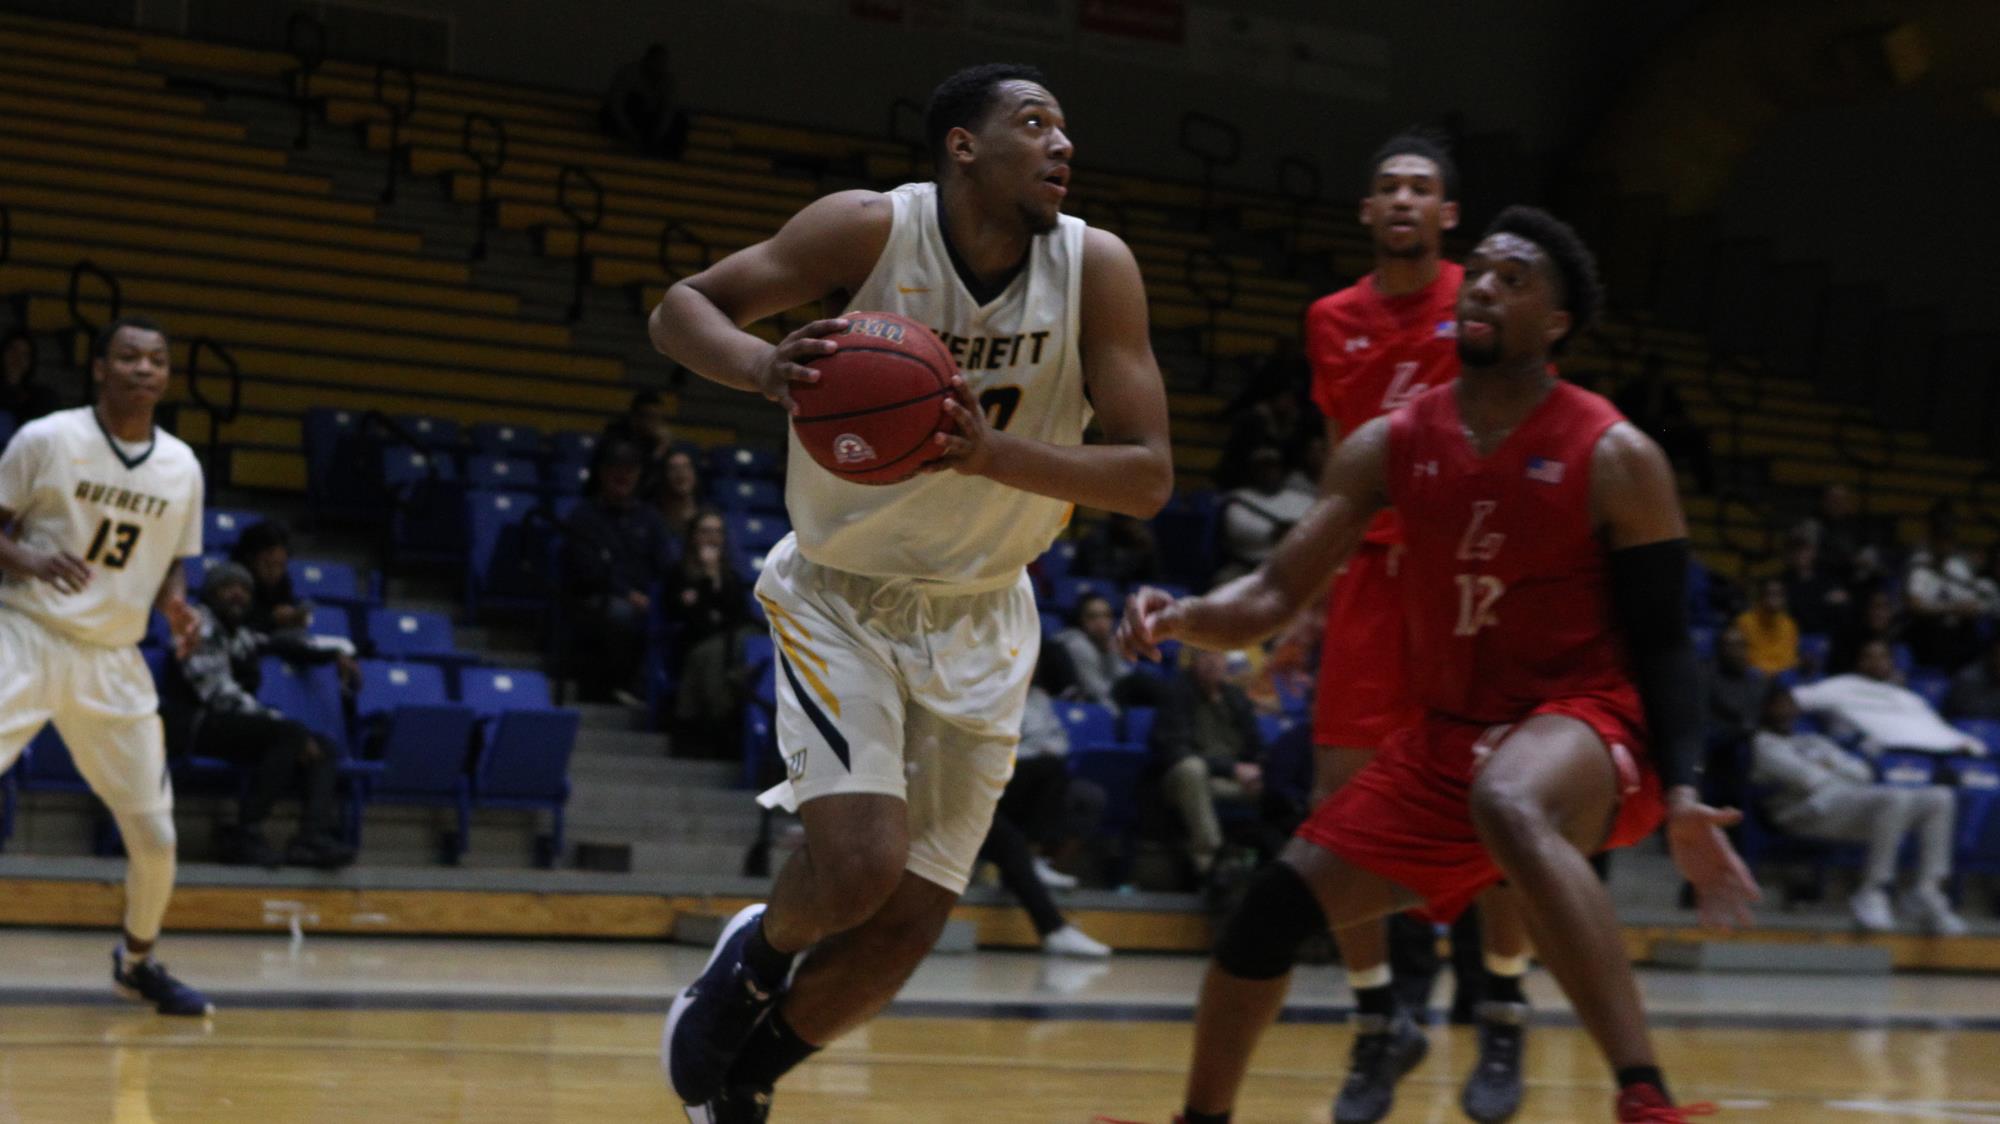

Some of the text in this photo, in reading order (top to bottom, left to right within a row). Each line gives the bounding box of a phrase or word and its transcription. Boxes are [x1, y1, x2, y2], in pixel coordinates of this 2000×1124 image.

[931, 330, 1050, 370] ERETT
[86, 518, 141, 569] 13
[1453, 573, 1507, 638] 12
